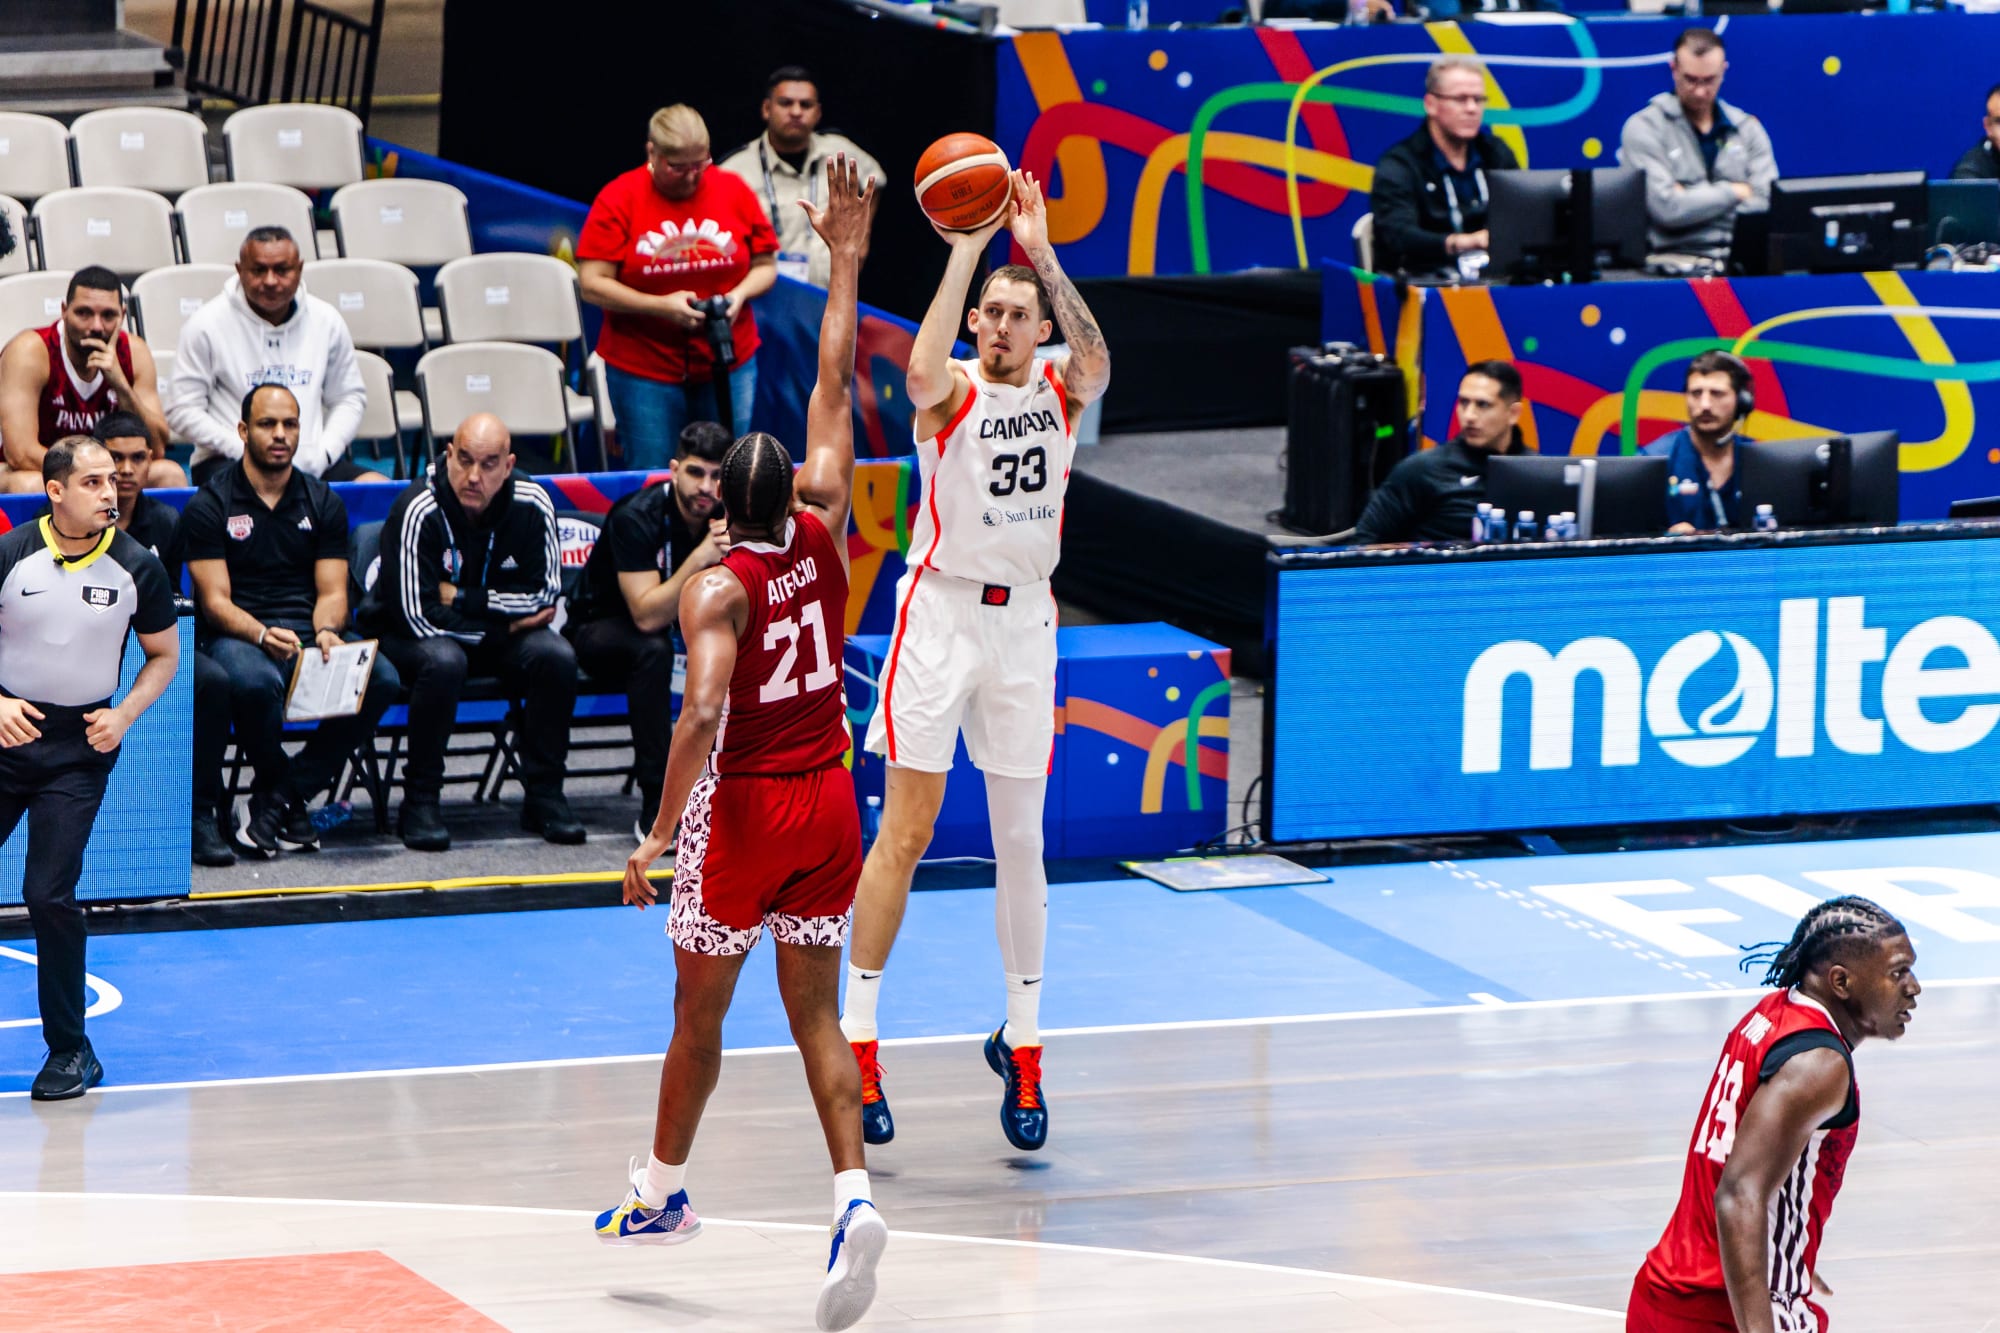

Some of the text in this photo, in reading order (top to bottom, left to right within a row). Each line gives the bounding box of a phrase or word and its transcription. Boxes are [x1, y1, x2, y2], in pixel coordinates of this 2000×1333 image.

[642, 255, 735, 276] BASKETBALL
[979, 409, 1060, 440] CANADA
[989, 445, 1048, 497] 33
[1005, 505, 1056, 524] Sun Life
[759, 599, 838, 704] 21
